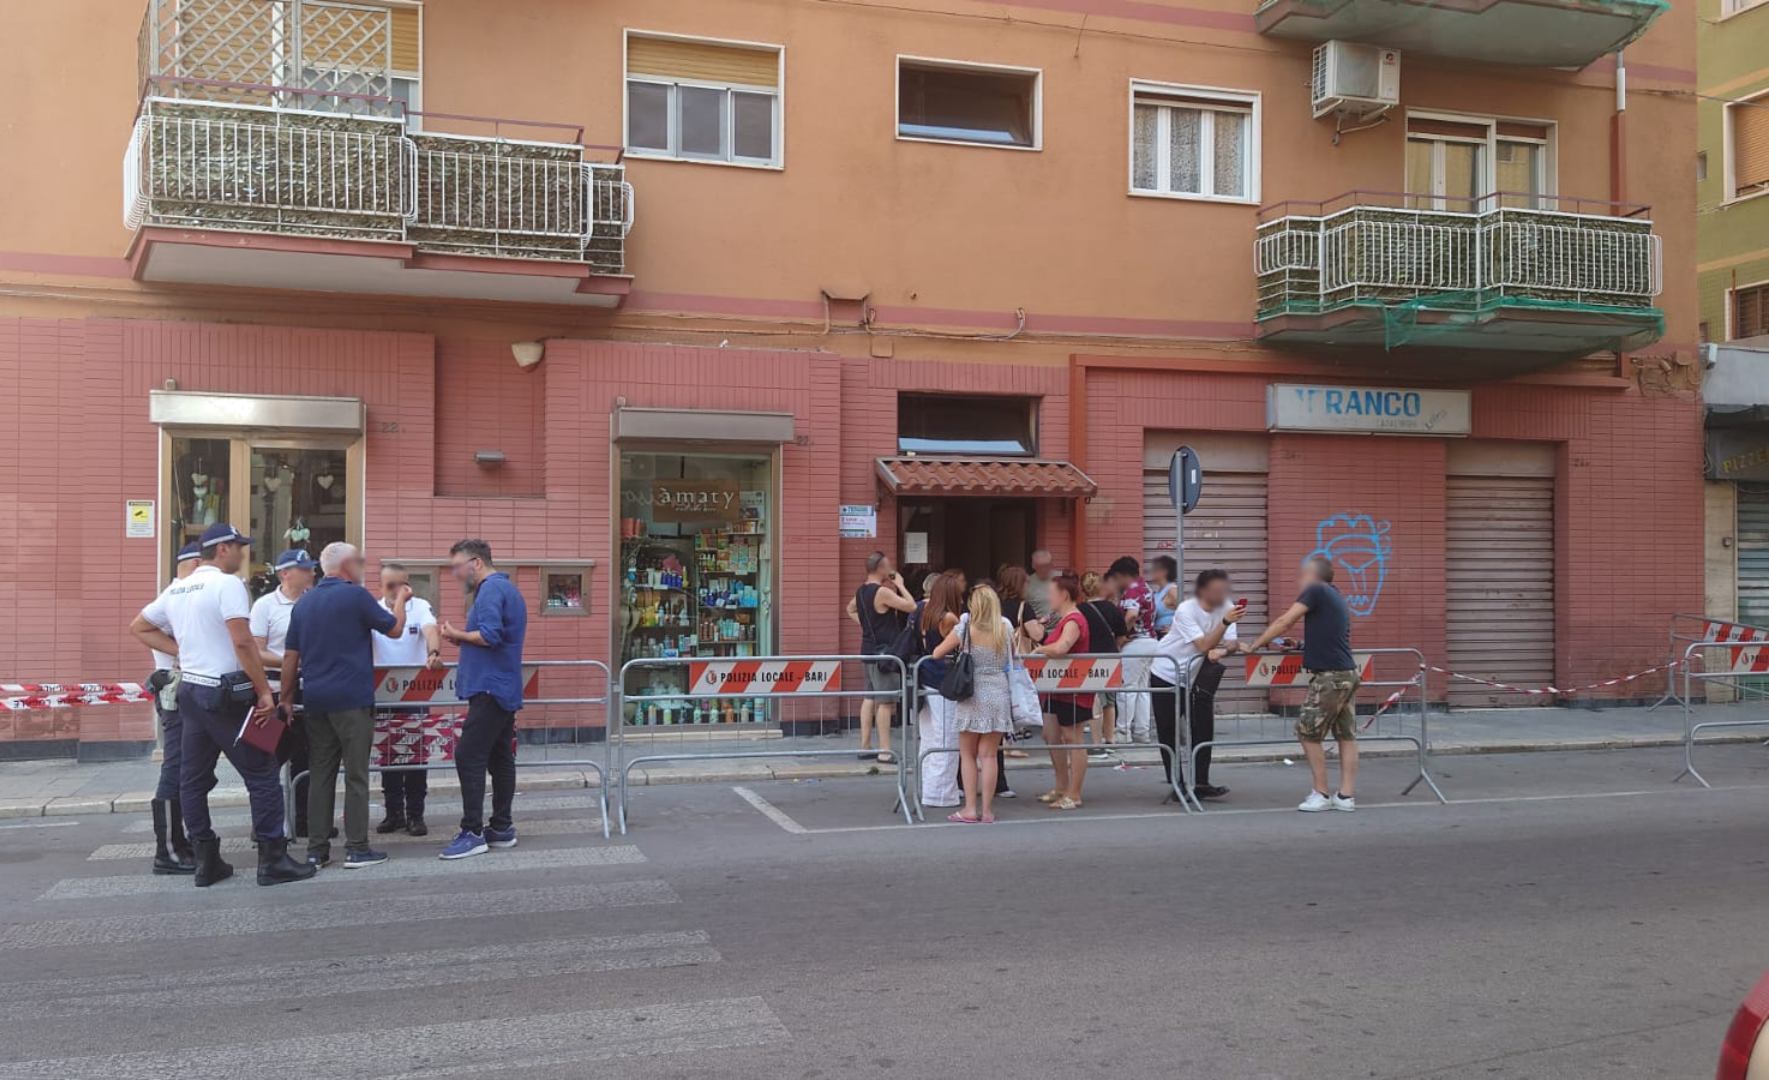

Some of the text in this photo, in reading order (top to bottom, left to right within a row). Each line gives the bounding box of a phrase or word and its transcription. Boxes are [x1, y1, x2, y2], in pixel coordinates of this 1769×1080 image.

[659, 487, 734, 510] àmaty
[720, 672, 757, 683] POLIZIA
[761, 671, 794, 682] LOCALE
[804, 671, 827, 682] BARI
[1047, 668, 1078, 679] LOCALE
[1088, 668, 1109, 678] BARI
[402, 679, 444, 691] POLIZIA
